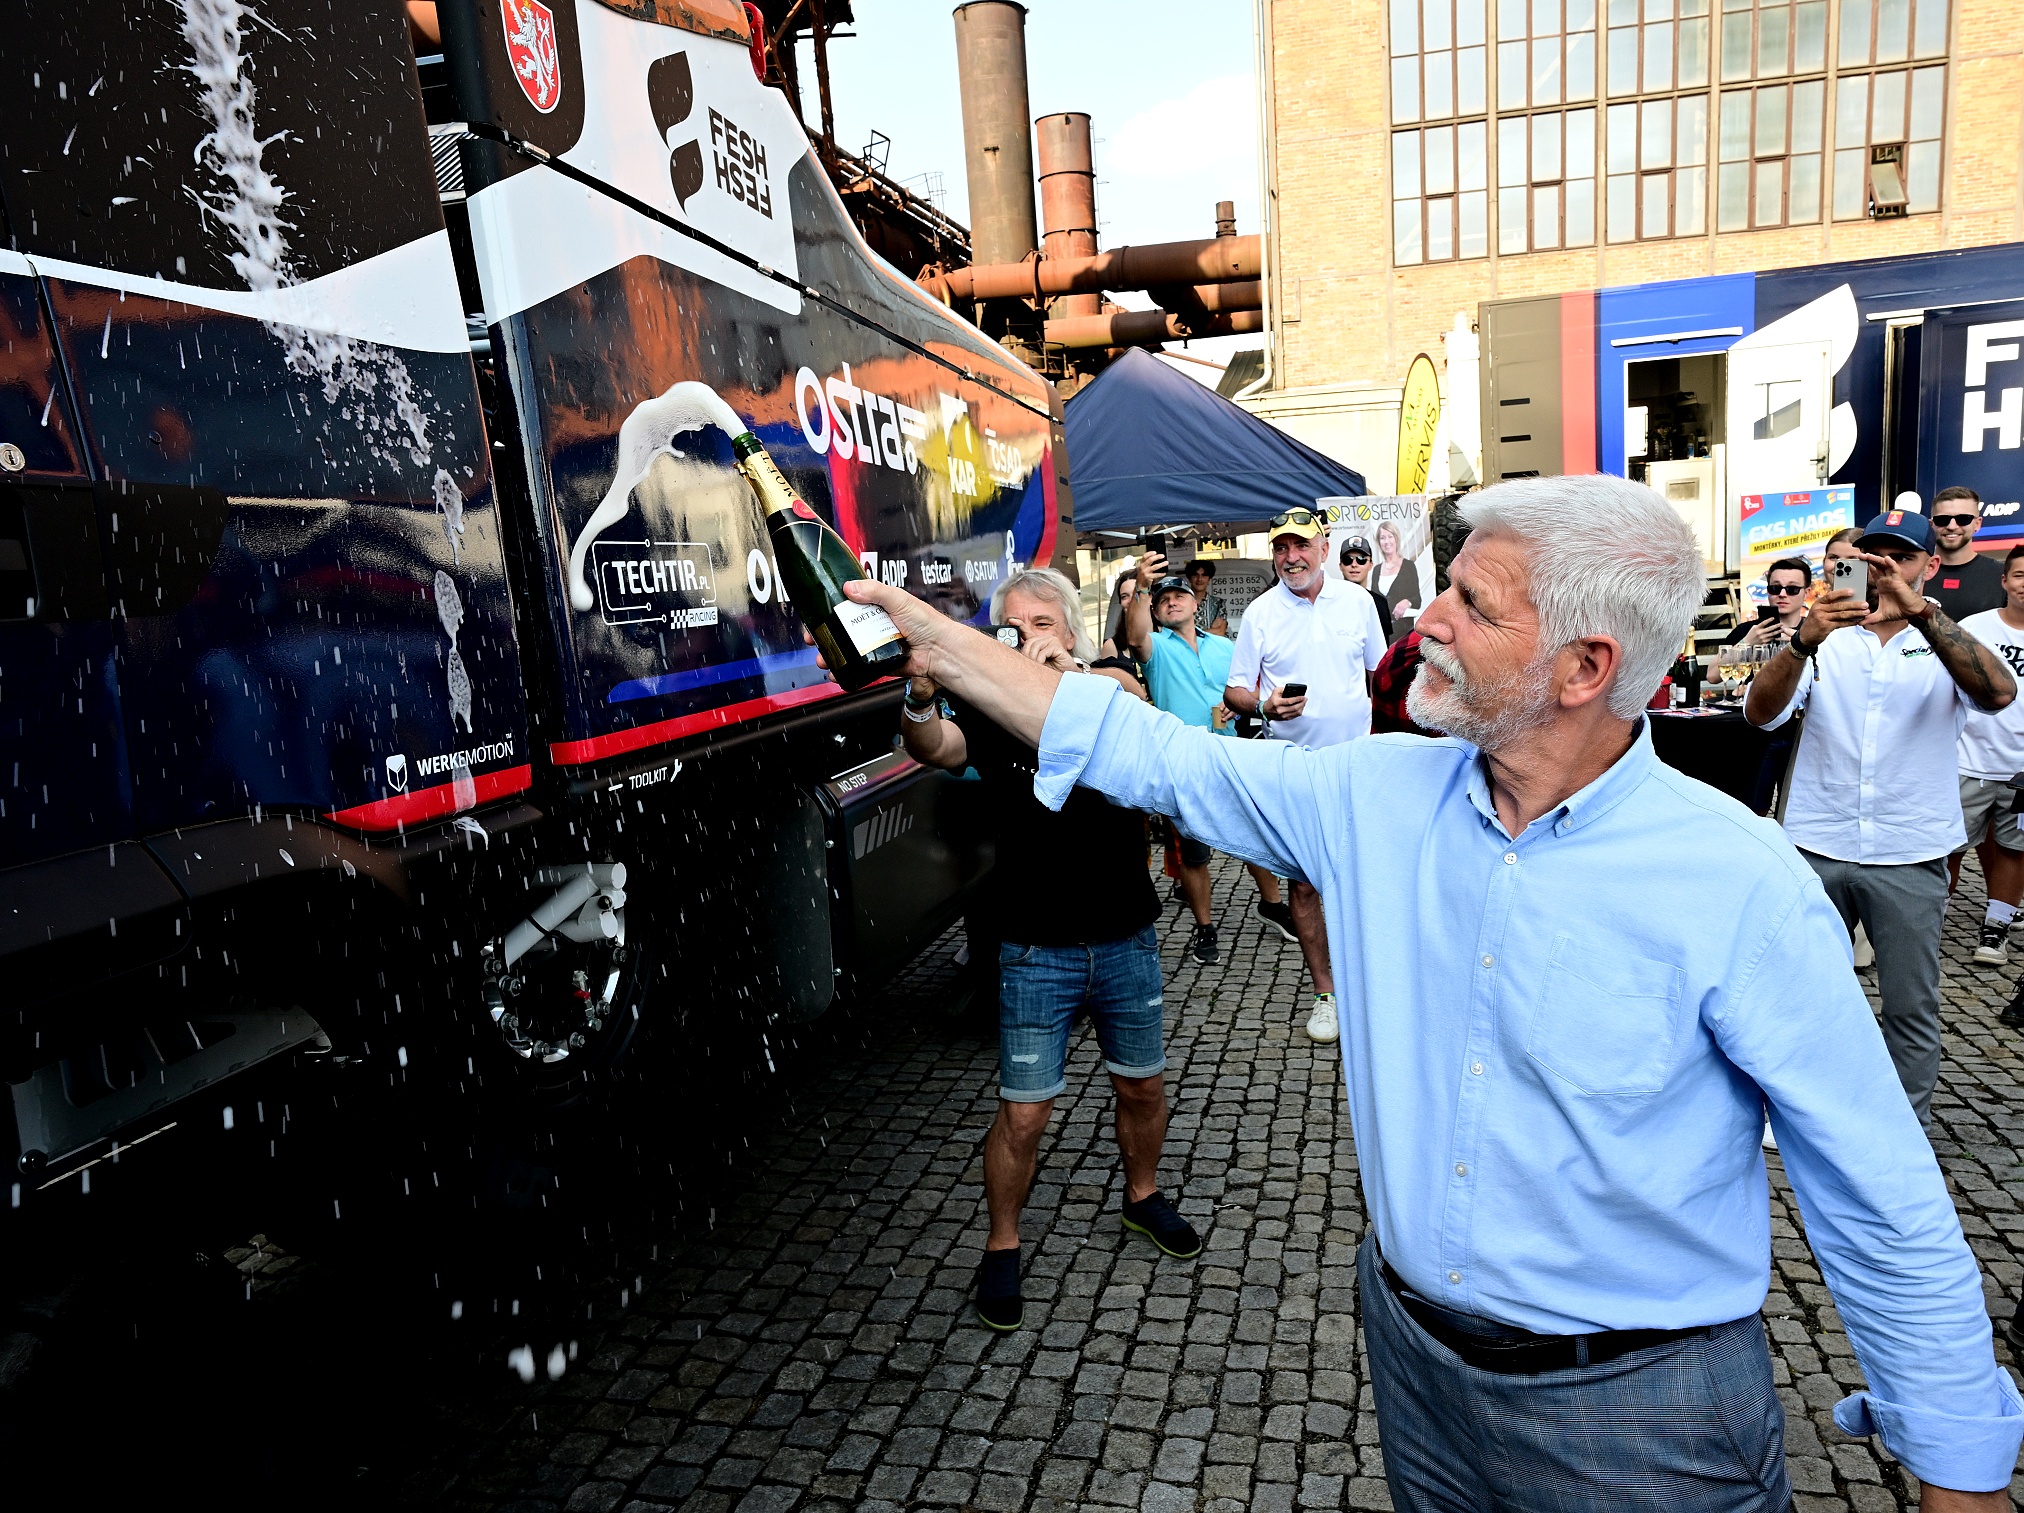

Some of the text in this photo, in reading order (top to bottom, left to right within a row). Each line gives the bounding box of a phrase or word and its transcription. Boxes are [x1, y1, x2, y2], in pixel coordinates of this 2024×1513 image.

[708, 106, 768, 181] FESH
[948, 456, 977, 496] KAR
[1983, 502, 2020, 517] ADIP
[1790, 508, 1846, 538] NAOS
[882, 560, 907, 587] ADIP
[921, 561, 951, 585] testcar
[974, 560, 998, 582] SATUM
[1229, 577, 1244, 585] 313
[1246, 576, 1260, 584] 652
[689, 610, 717, 623] RACING
[416, 741, 514, 777] WERKEMOTION
[629, 766, 668, 790] TOOLKIT
[837, 772, 868, 793] NO STEP
